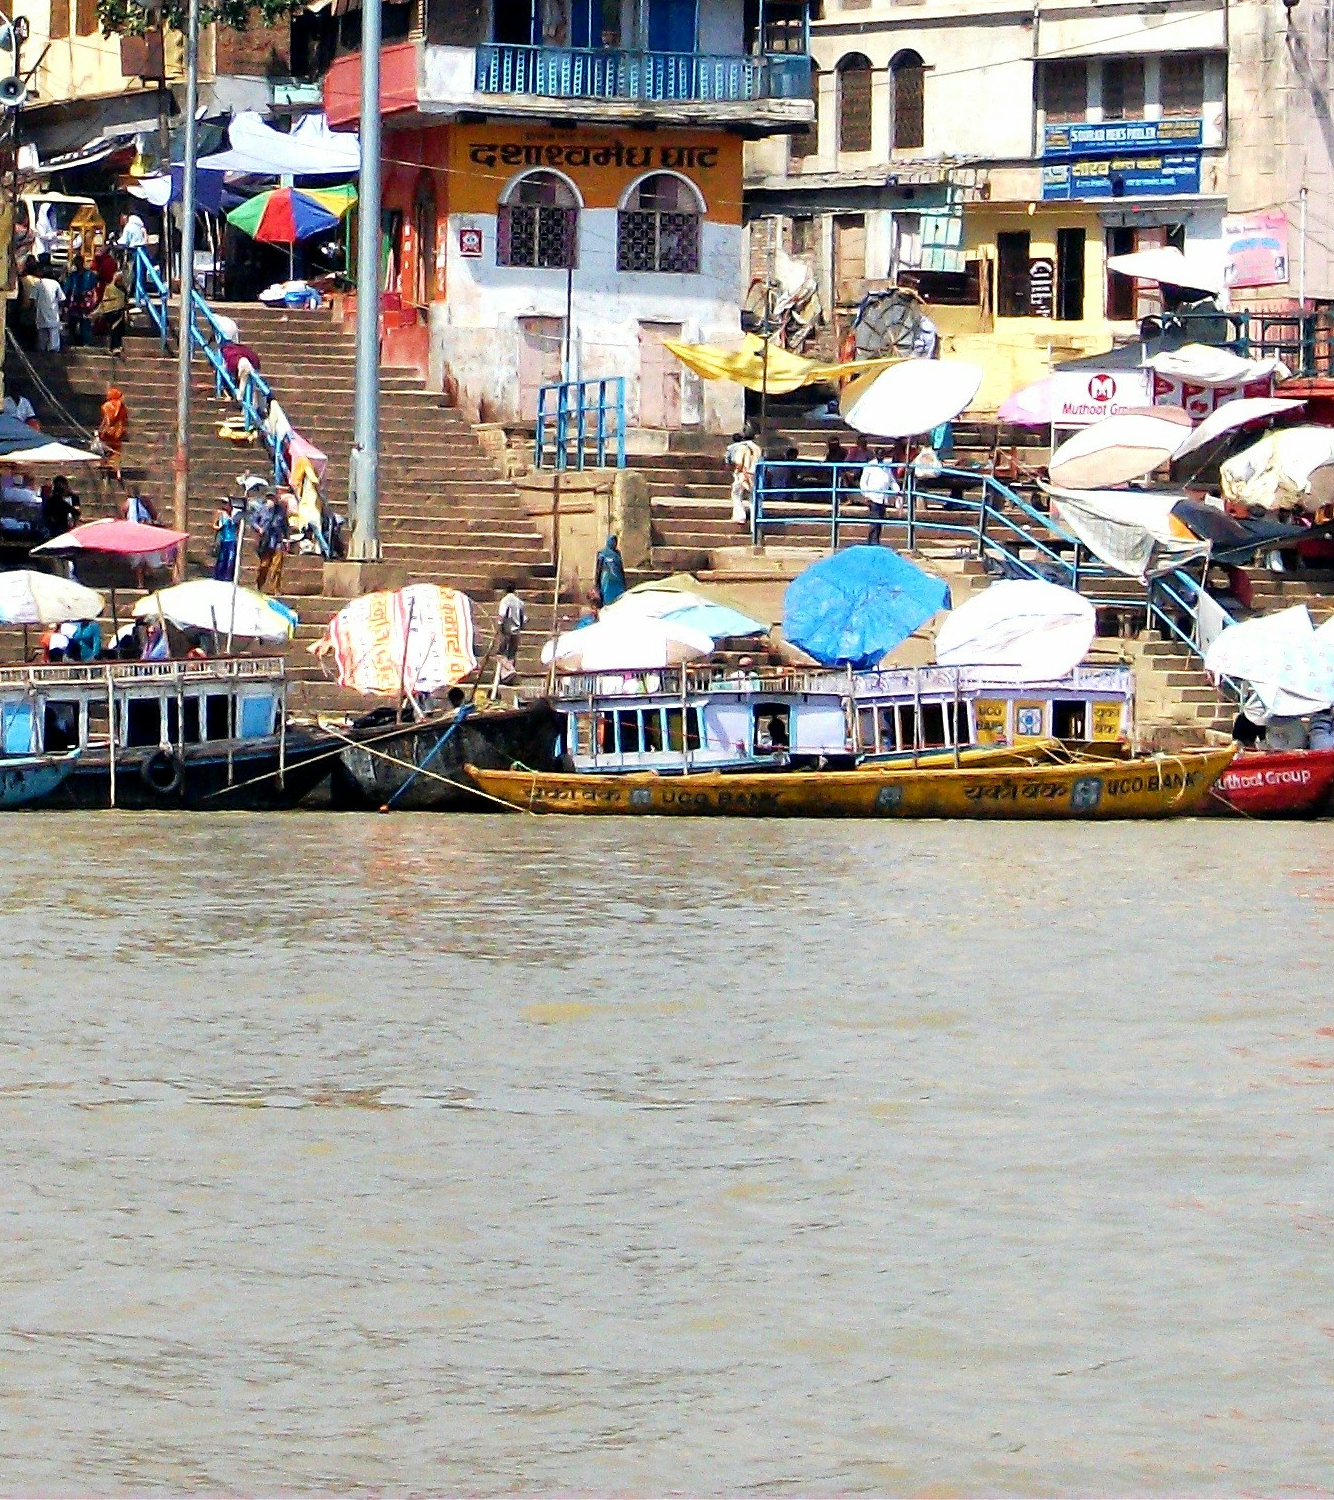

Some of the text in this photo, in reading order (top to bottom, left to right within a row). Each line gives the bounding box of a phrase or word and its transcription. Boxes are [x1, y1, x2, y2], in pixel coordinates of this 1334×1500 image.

[469, 140, 720, 169] दशाश्वमेध घाट
[1062, 402, 1107, 416] Muthoot
[1108, 772, 1196, 796] UCO BANK
[1213, 769, 1312, 790] uthoot Group
